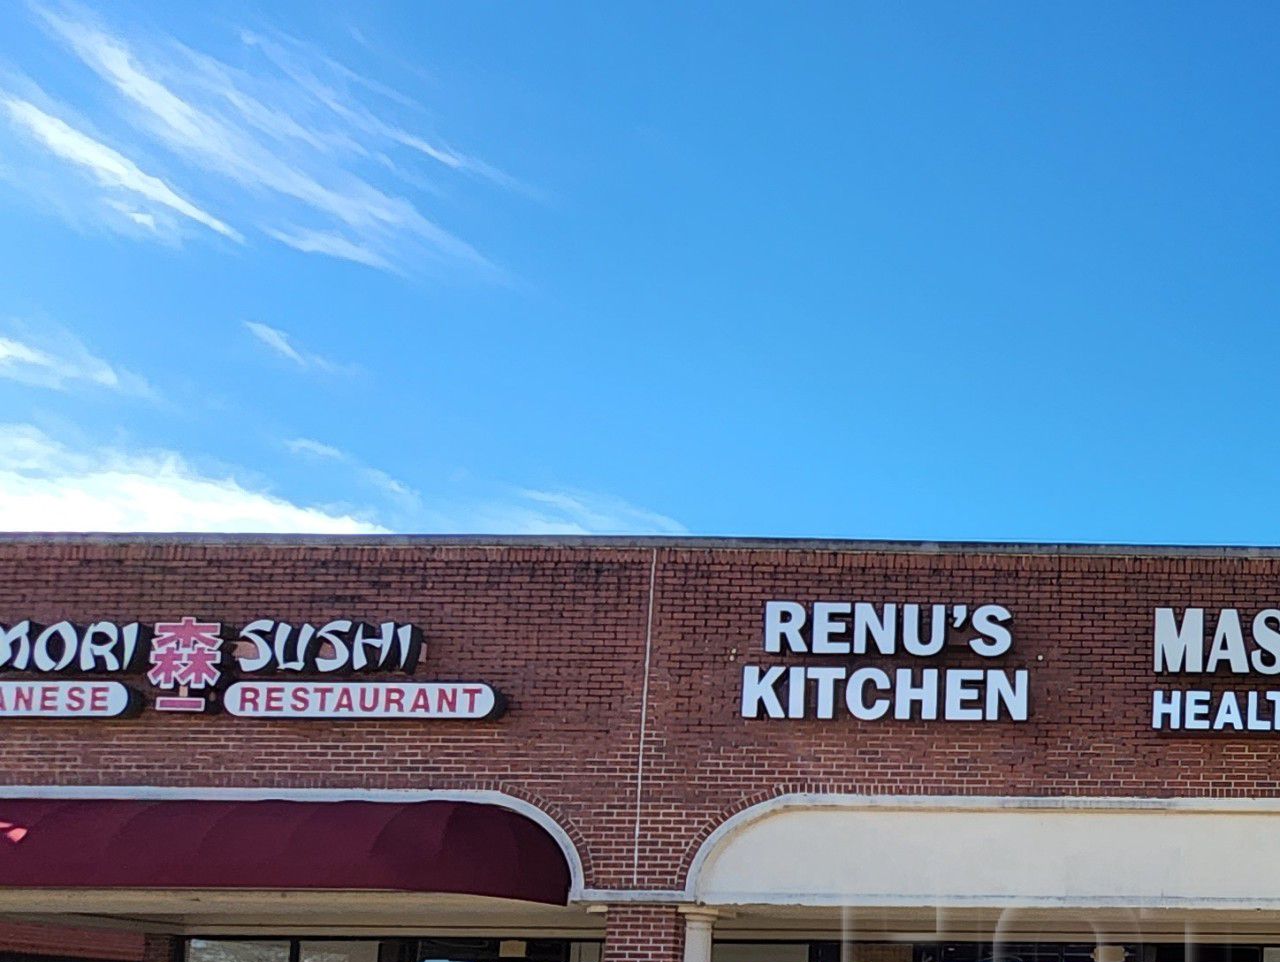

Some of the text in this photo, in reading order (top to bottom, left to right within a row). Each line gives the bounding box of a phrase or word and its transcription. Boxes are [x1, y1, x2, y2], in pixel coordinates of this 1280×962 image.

[237, 618, 413, 673] SUSHI
[765, 600, 1013, 657] RENU'S
[0, 686, 110, 712] NESE
[238, 686, 483, 714] RESTAURANT
[741, 665, 1029, 721] KITCHEN
